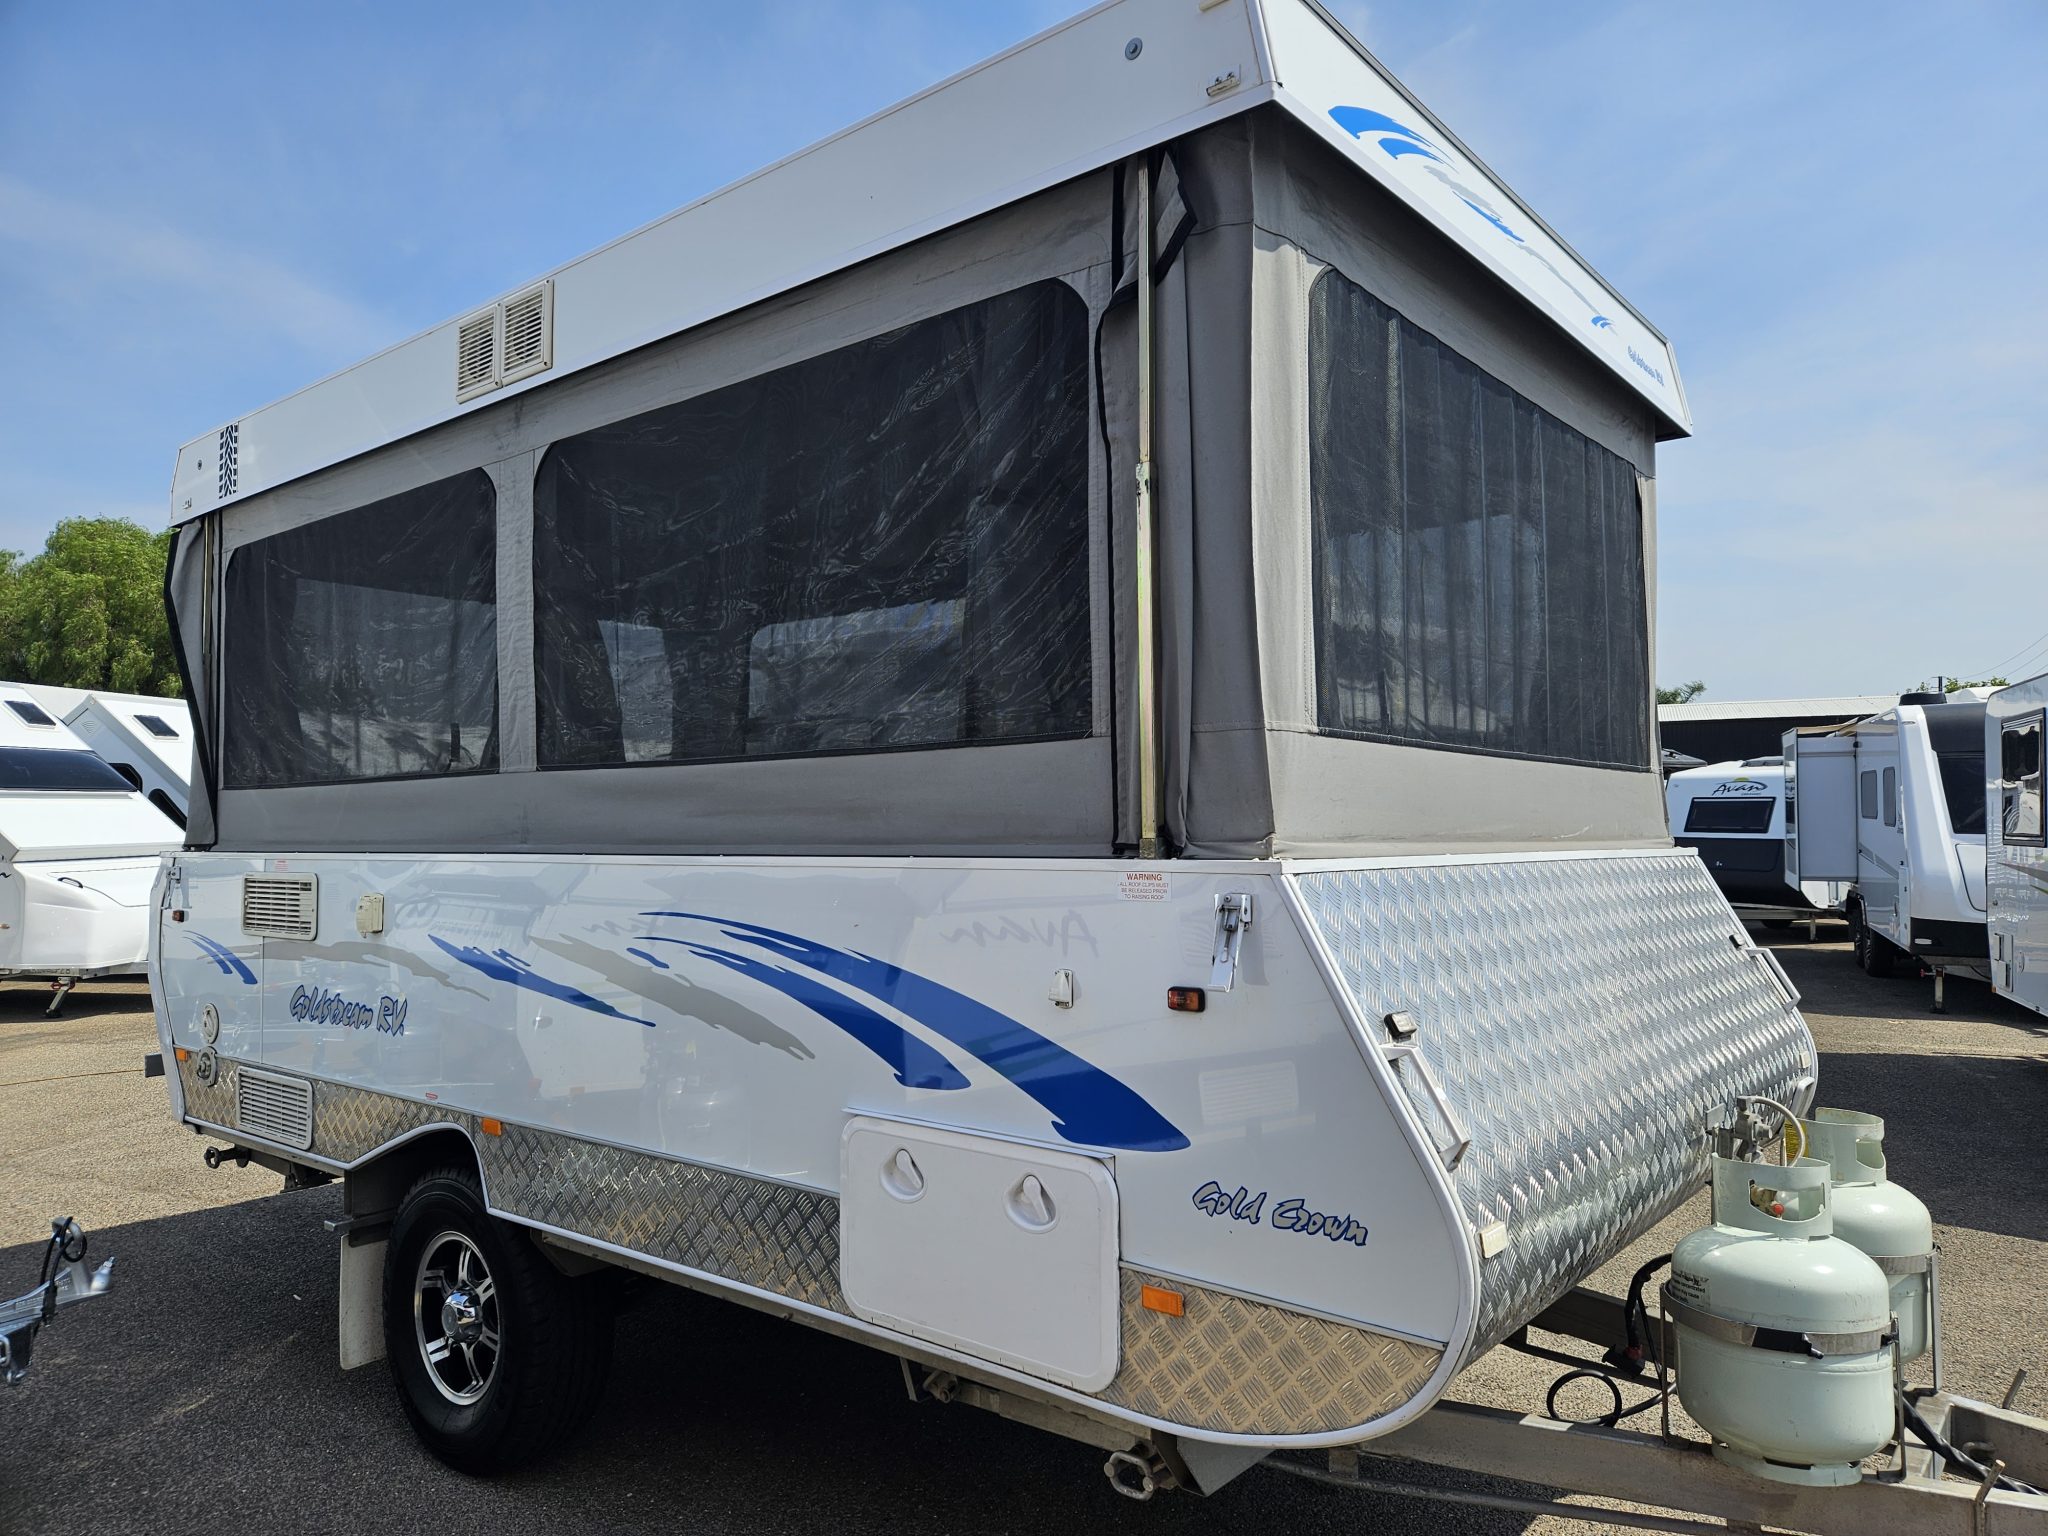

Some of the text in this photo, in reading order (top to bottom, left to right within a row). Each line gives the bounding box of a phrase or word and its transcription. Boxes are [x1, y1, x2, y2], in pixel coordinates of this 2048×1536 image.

[1712, 783, 1764, 796] Avan
[1126, 873, 1163, 881] WARNING
[289, 984, 374, 1030] Goldstream
[1192, 1180, 1369, 1246] Gold Crown
